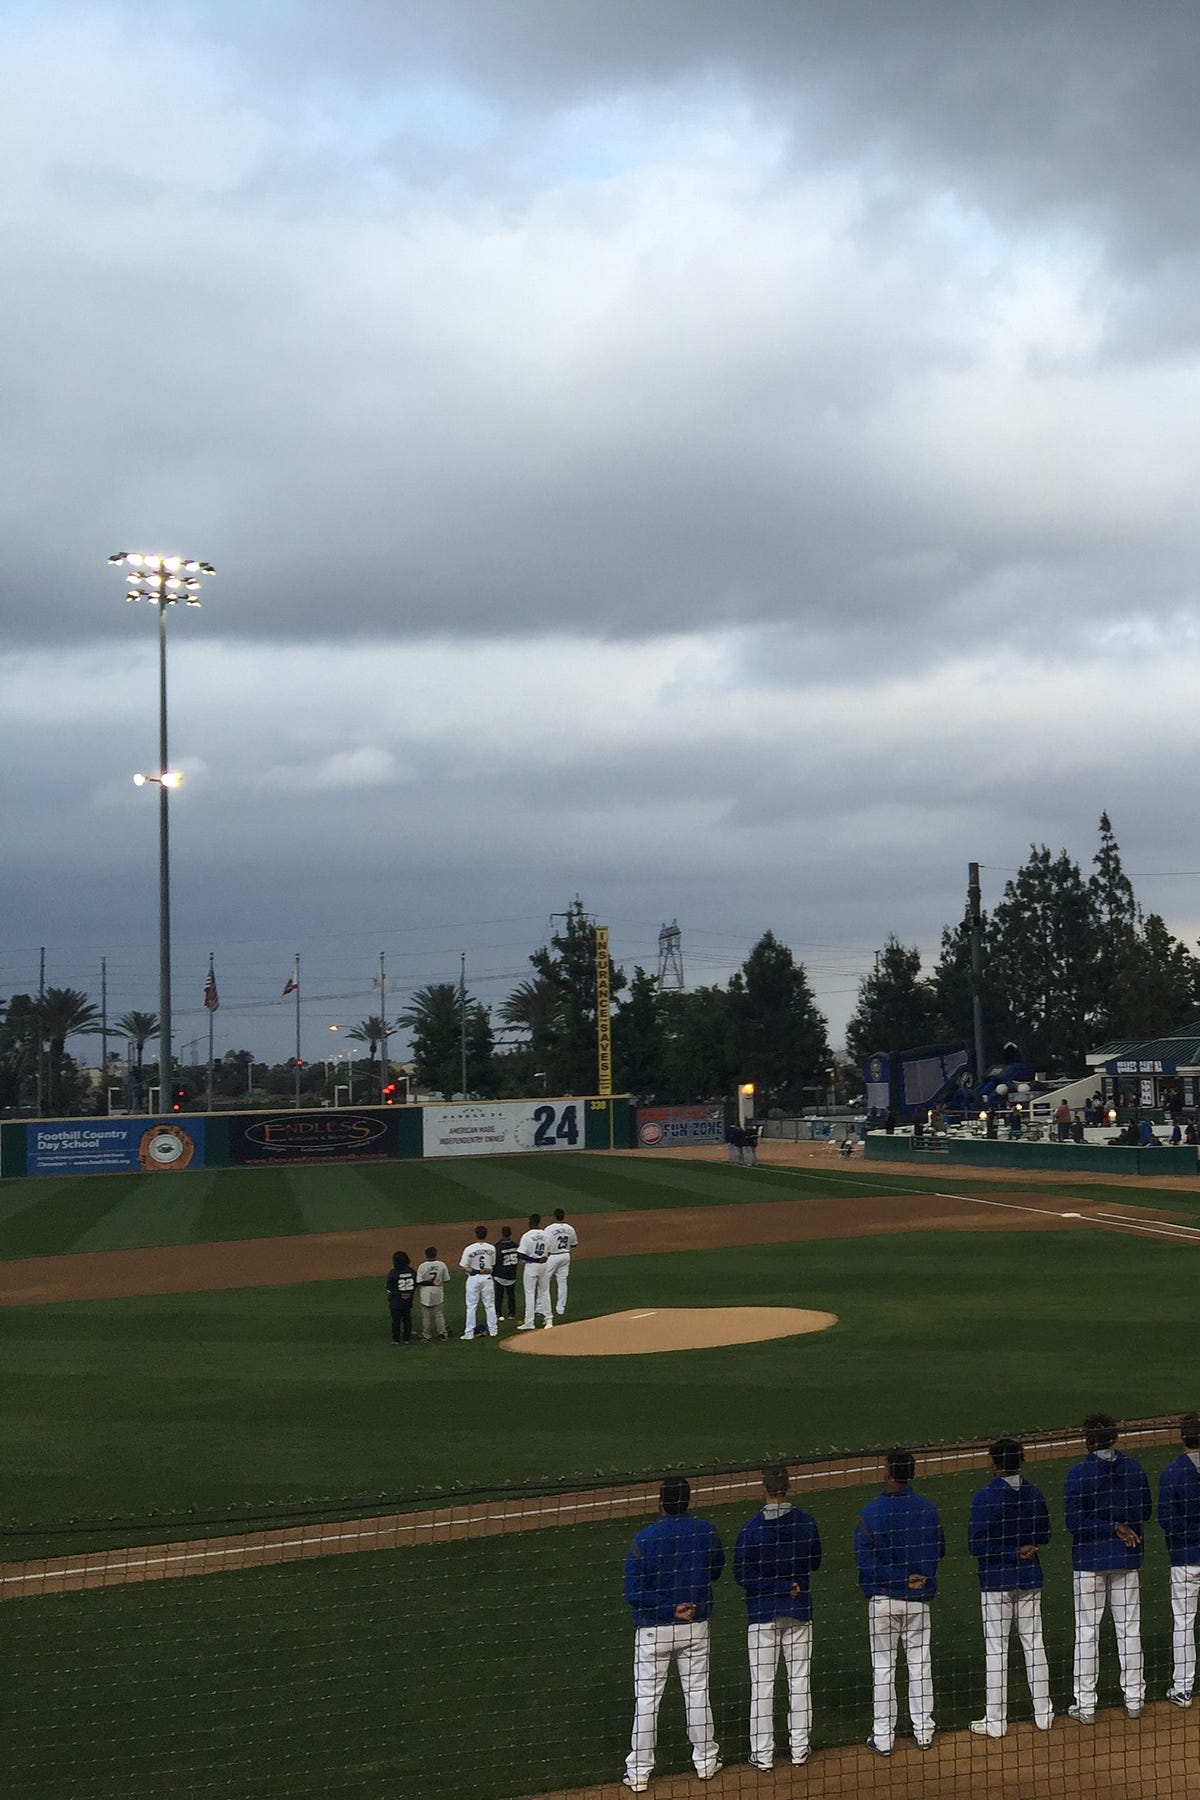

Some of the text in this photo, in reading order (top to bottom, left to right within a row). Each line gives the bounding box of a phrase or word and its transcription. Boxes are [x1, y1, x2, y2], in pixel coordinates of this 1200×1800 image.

[599, 931, 609, 1018] INSURANCE
[600, 1023, 609, 1071] SAVES
[264, 1120, 370, 1143] ENDLESS
[534, 1105, 579, 1146] 24
[663, 1122, 688, 1137] FUN
[693, 1121, 723, 1136] ZONE
[37, 1130, 128, 1141] Foothill Country
[37, 1139, 100, 1151] Day School
[398, 1278, 415, 1291] 22
